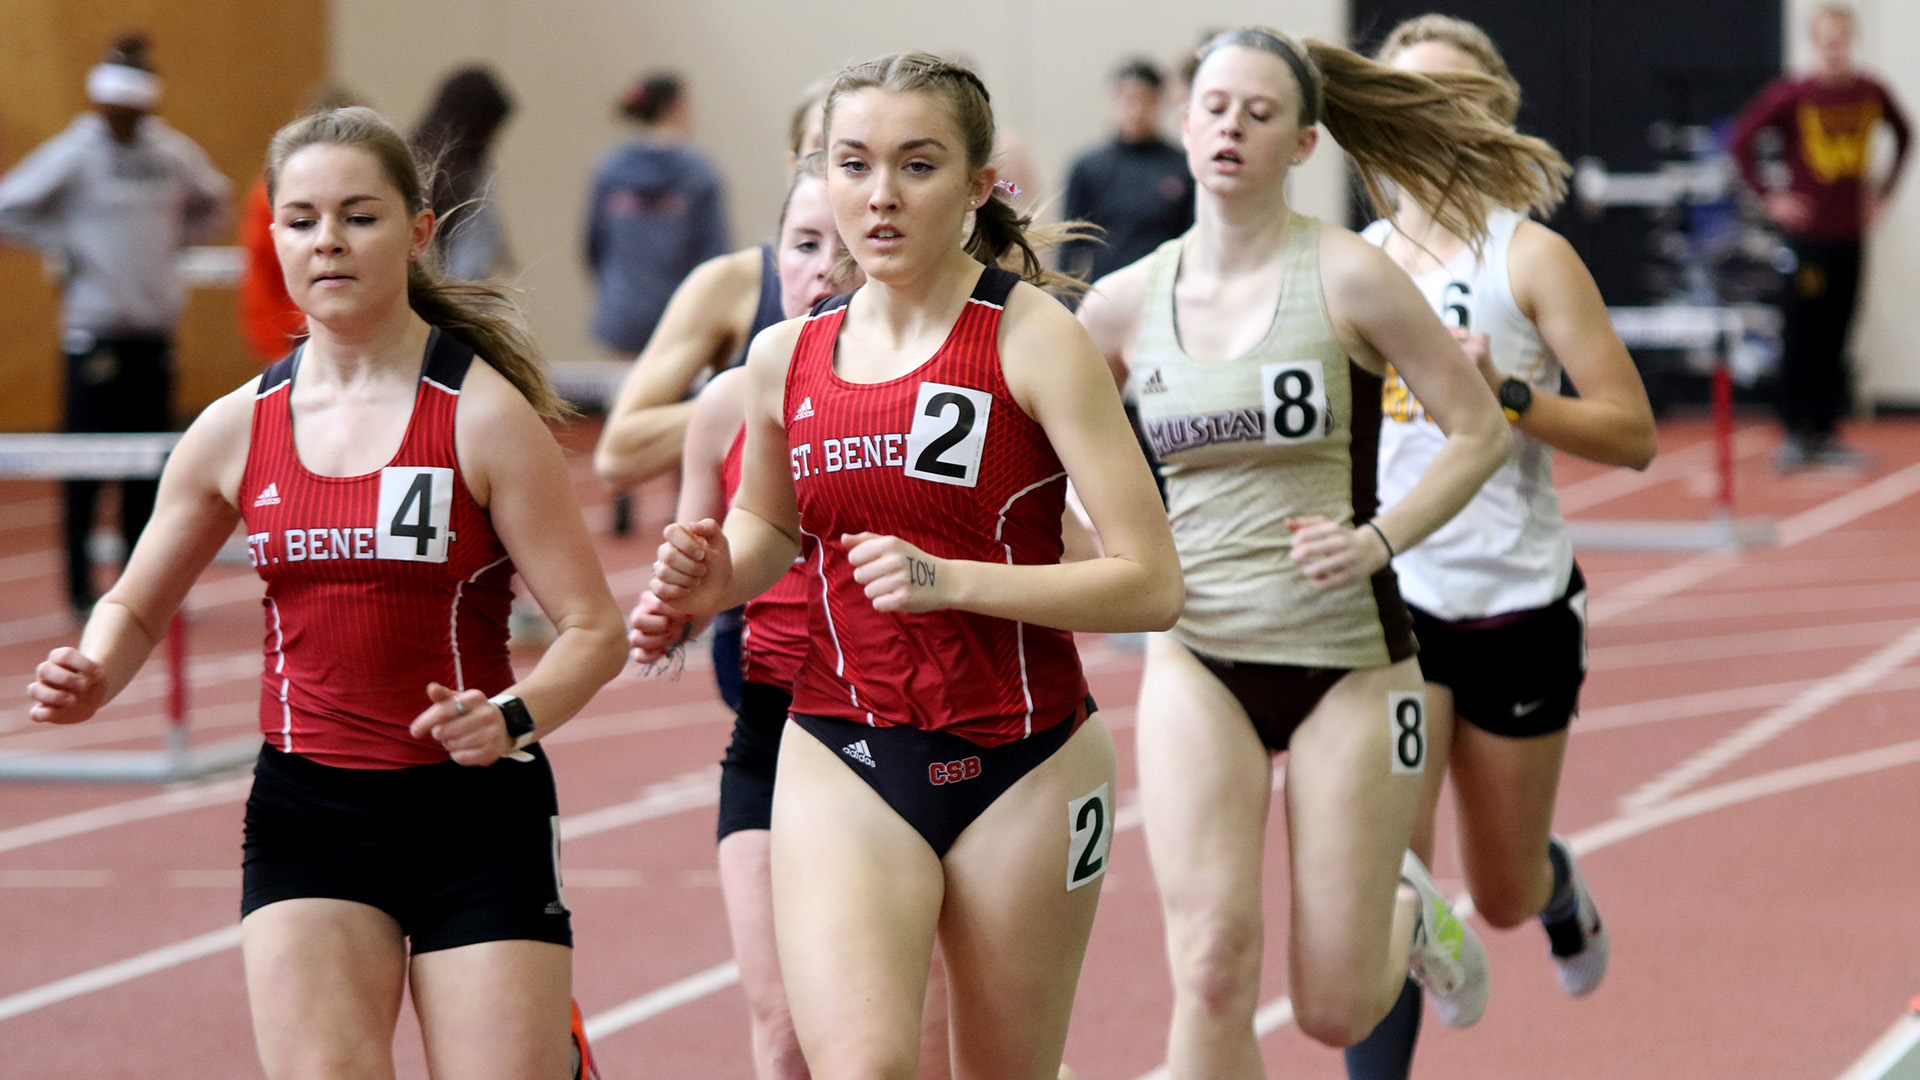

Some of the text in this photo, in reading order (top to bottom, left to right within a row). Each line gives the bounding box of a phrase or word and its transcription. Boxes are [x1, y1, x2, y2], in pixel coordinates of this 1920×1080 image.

[1444, 282, 1470, 328] 6
[1149, 406, 1333, 456] MUSTA
[1273, 368, 1318, 438] 8
[823, 433, 910, 473] BENE
[914, 391, 977, 479] 2
[390, 472, 438, 556] 4
[842, 745, 877, 769] adidas
[1396, 697, 1424, 770] 8
[928, 755, 982, 786] CSB
[1072, 796, 1104, 883] 2
